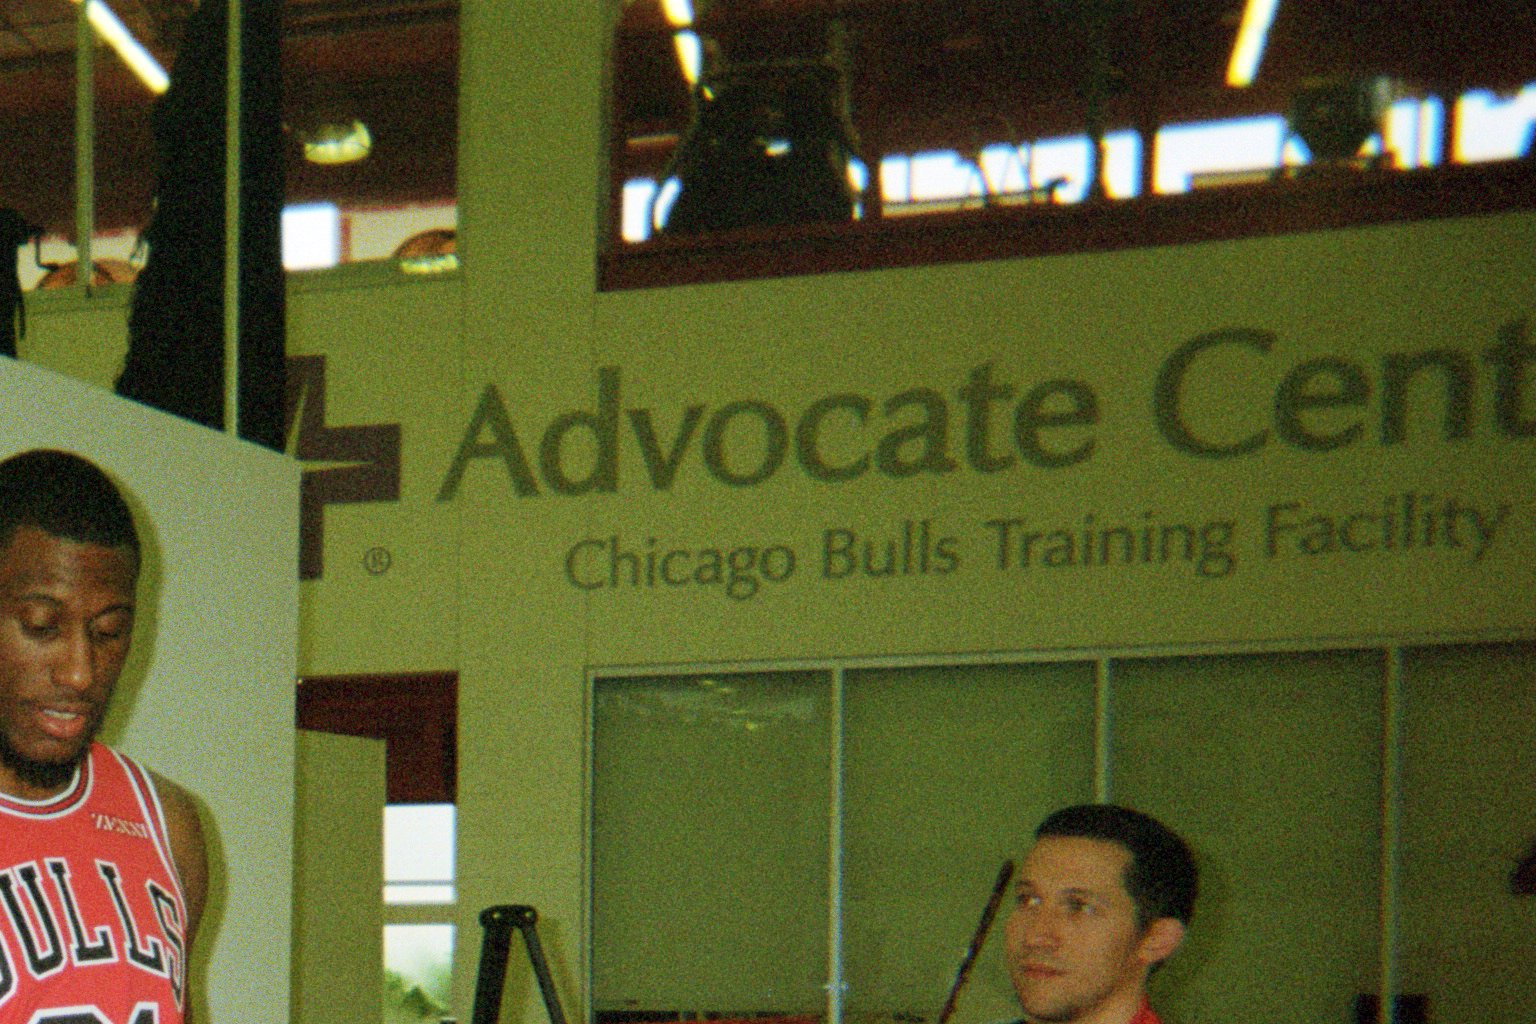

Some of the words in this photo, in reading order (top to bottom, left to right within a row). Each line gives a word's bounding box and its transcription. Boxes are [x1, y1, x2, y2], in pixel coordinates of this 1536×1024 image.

[436, 361, 1100, 503] Advocate
[564, 535, 797, 601] Chicago
[823, 519, 961, 580] Bulls
[984, 509, 1237, 578] Training
[1265, 492, 1511, 565] Facility
